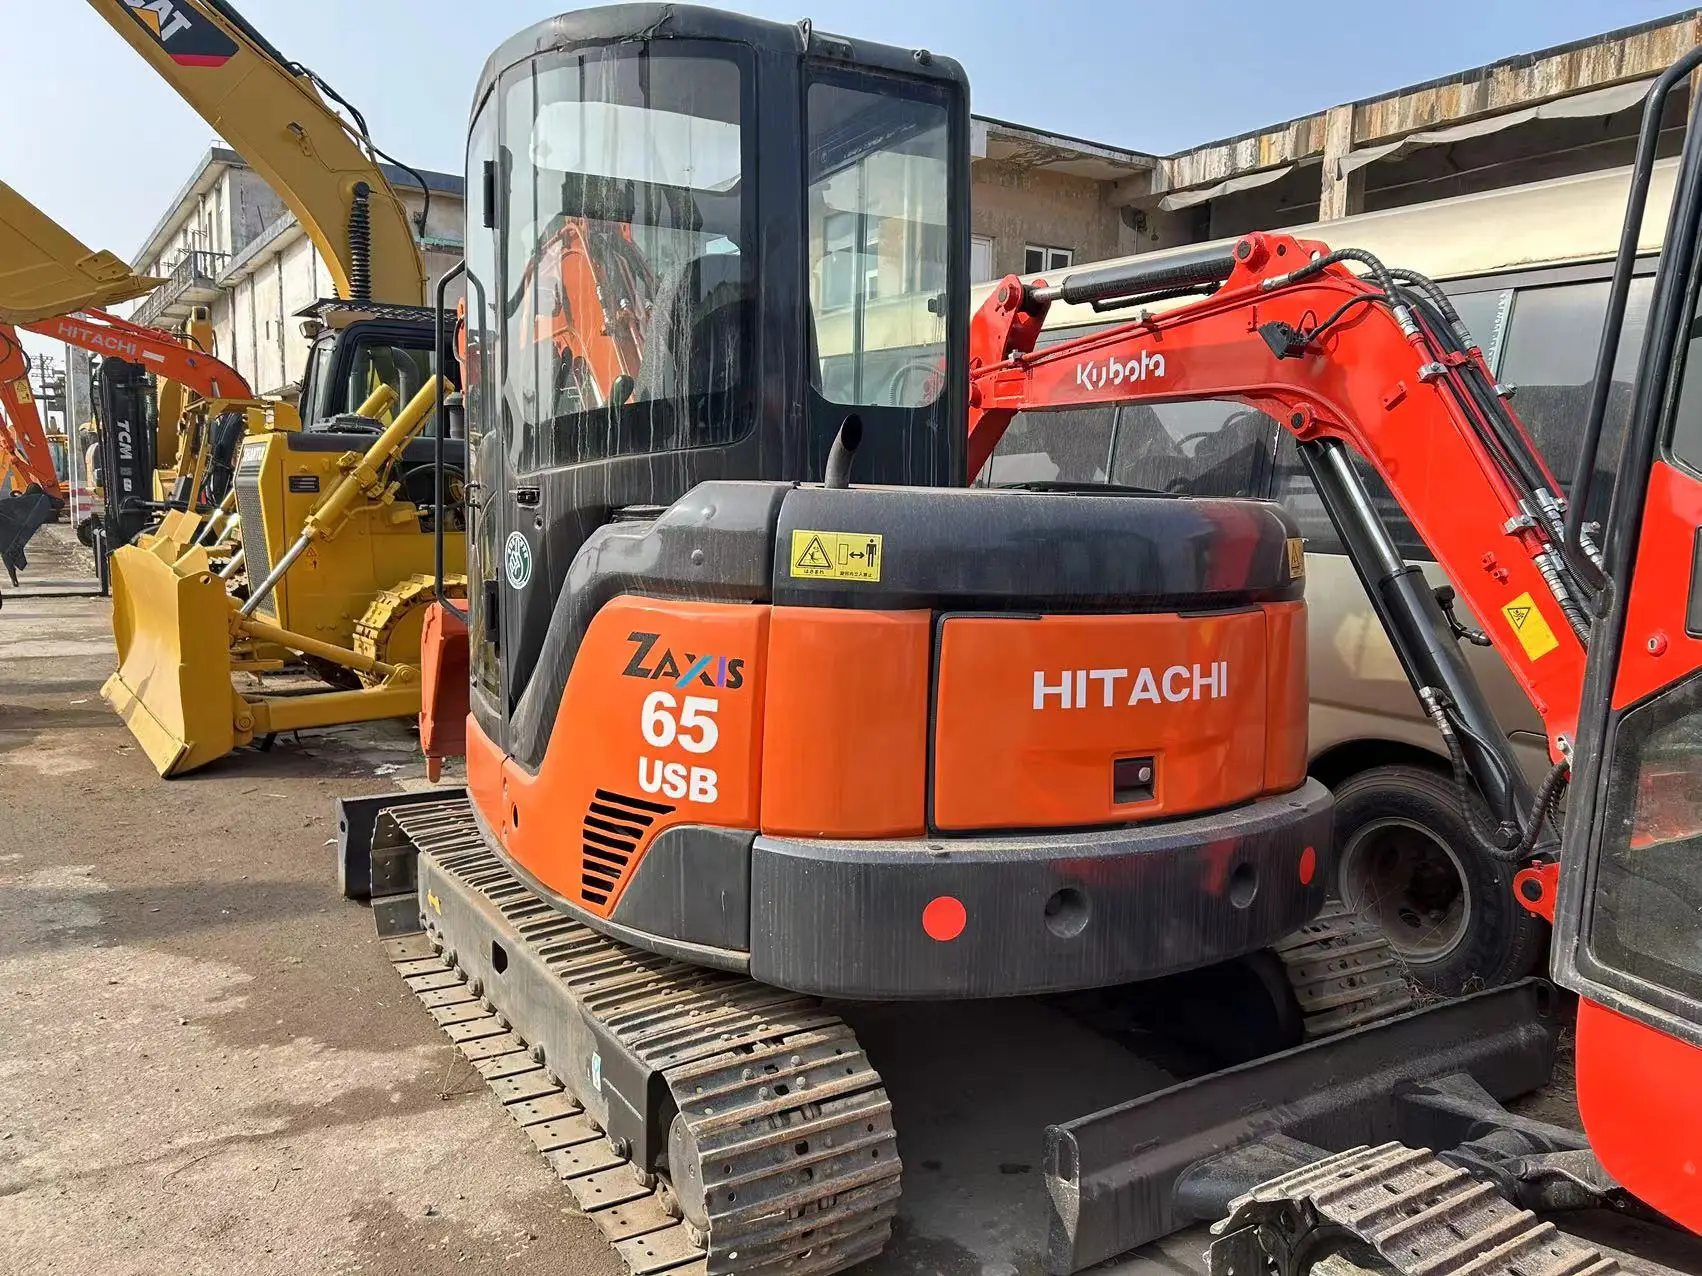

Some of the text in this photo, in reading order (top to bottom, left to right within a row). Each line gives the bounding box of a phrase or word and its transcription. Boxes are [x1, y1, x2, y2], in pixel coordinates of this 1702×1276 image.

[58, 323, 137, 355] HITACHI
[1077, 349, 1165, 390] Kubota
[117, 420, 133, 459] TCM
[1033, 662, 1227, 710] HITACHI
[641, 690, 719, 754] 65
[638, 756, 718, 804] USB
